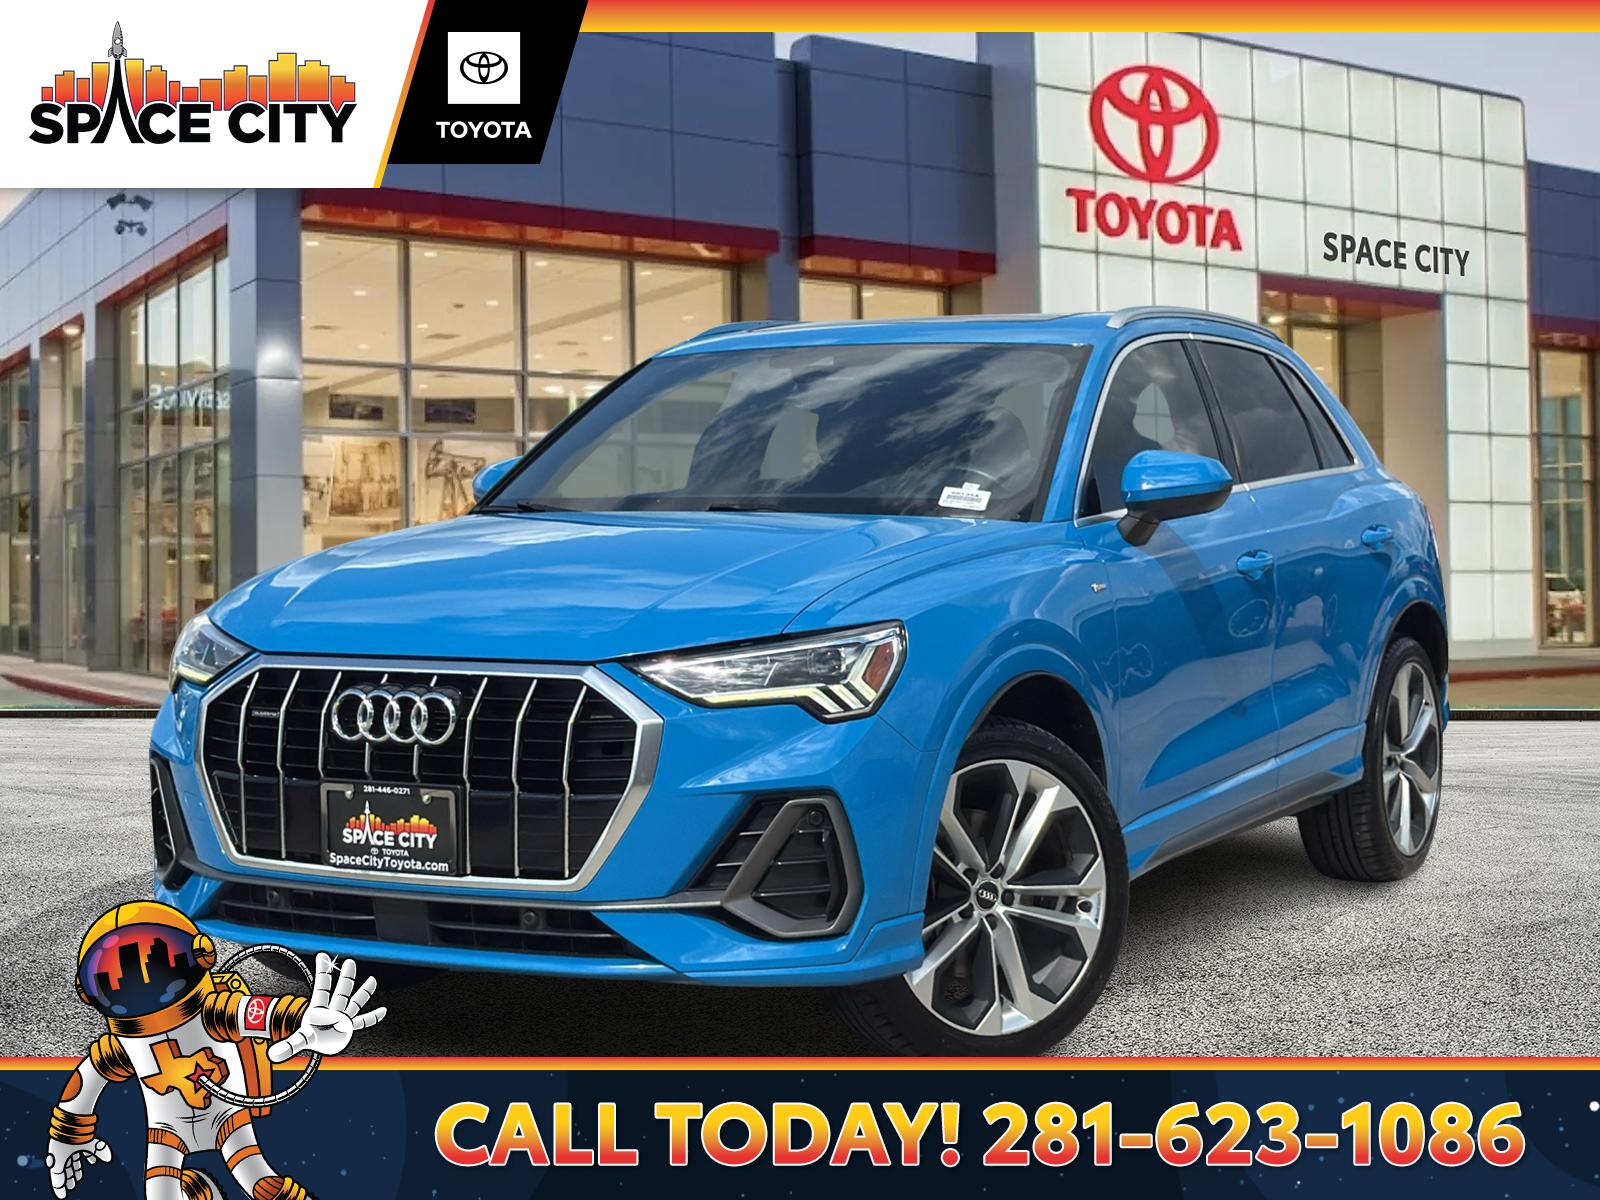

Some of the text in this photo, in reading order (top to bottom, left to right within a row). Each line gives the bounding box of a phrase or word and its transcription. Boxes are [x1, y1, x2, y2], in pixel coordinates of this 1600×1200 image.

[1065, 187, 1242, 251] TOYOTA
[1323, 231, 1470, 277] SPACE CITY
[363, 785, 410, 795] 281-446-0271
[342, 827, 437, 849] SPACE CITY
[329, 852, 449, 872] SpaceCityToyota.com
[382, 848, 409, 857] TOYOTA
